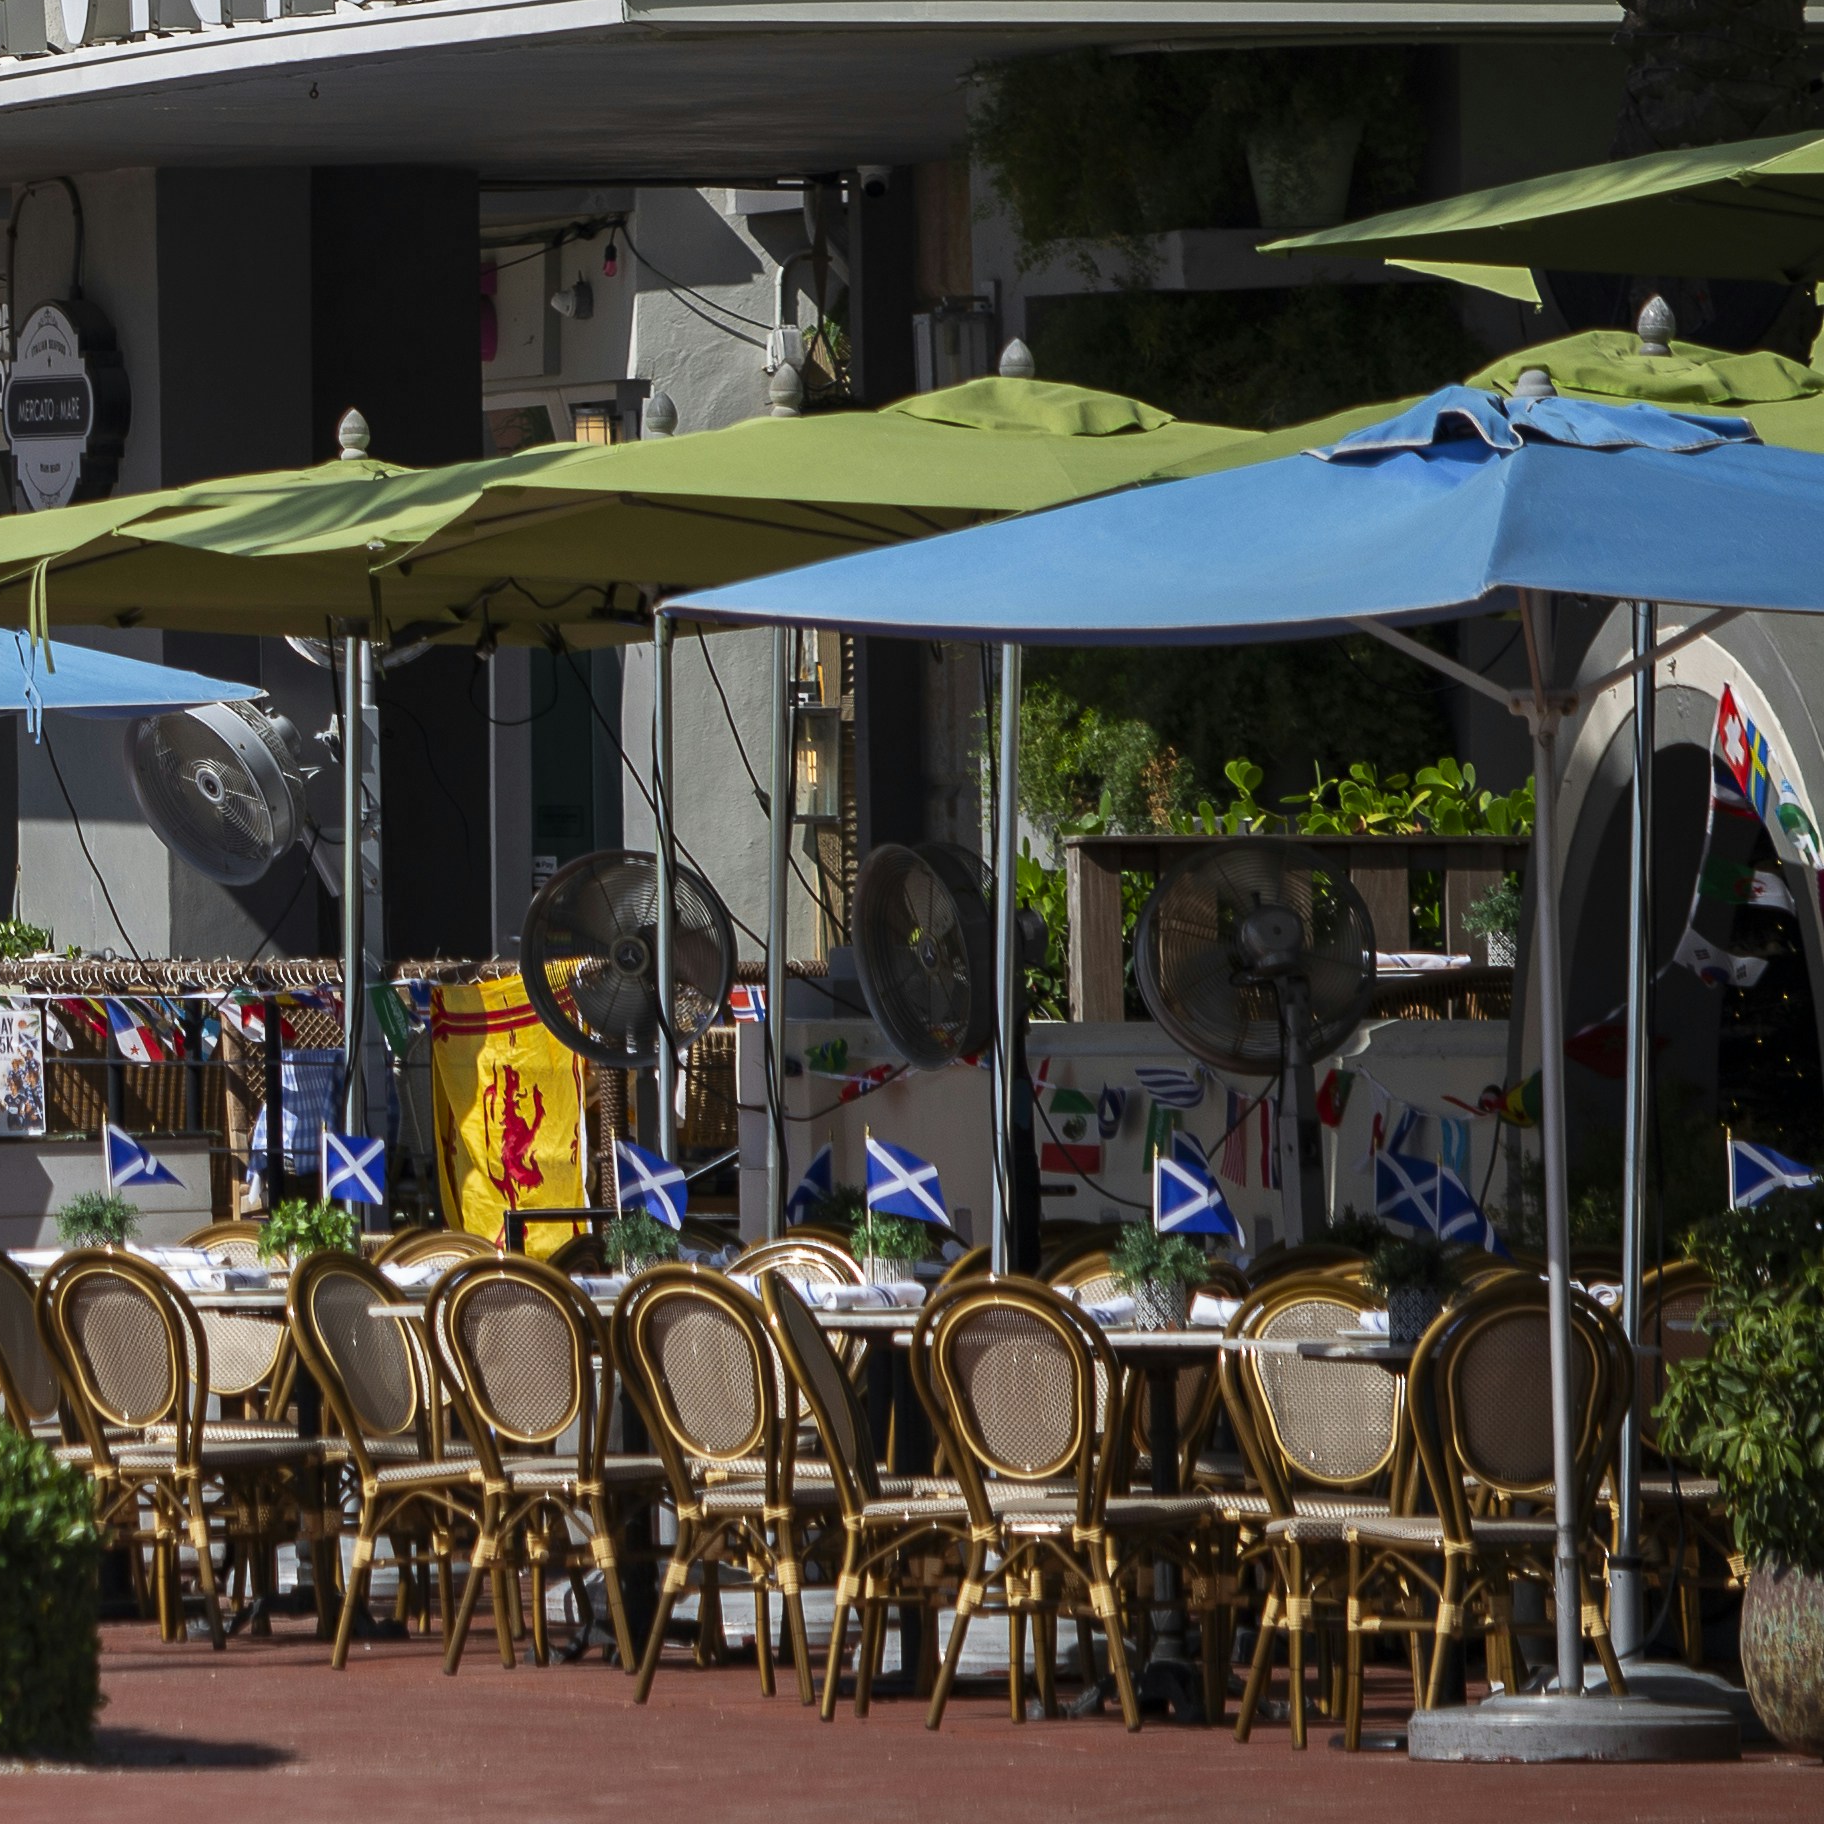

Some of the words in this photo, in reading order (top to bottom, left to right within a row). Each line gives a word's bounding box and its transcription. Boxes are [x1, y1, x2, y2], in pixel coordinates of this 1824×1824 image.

[18, 398, 54, 422] MERCATO
[60, 397, 80, 420] MARE
[0, 1036, 14, 1054] 5K
